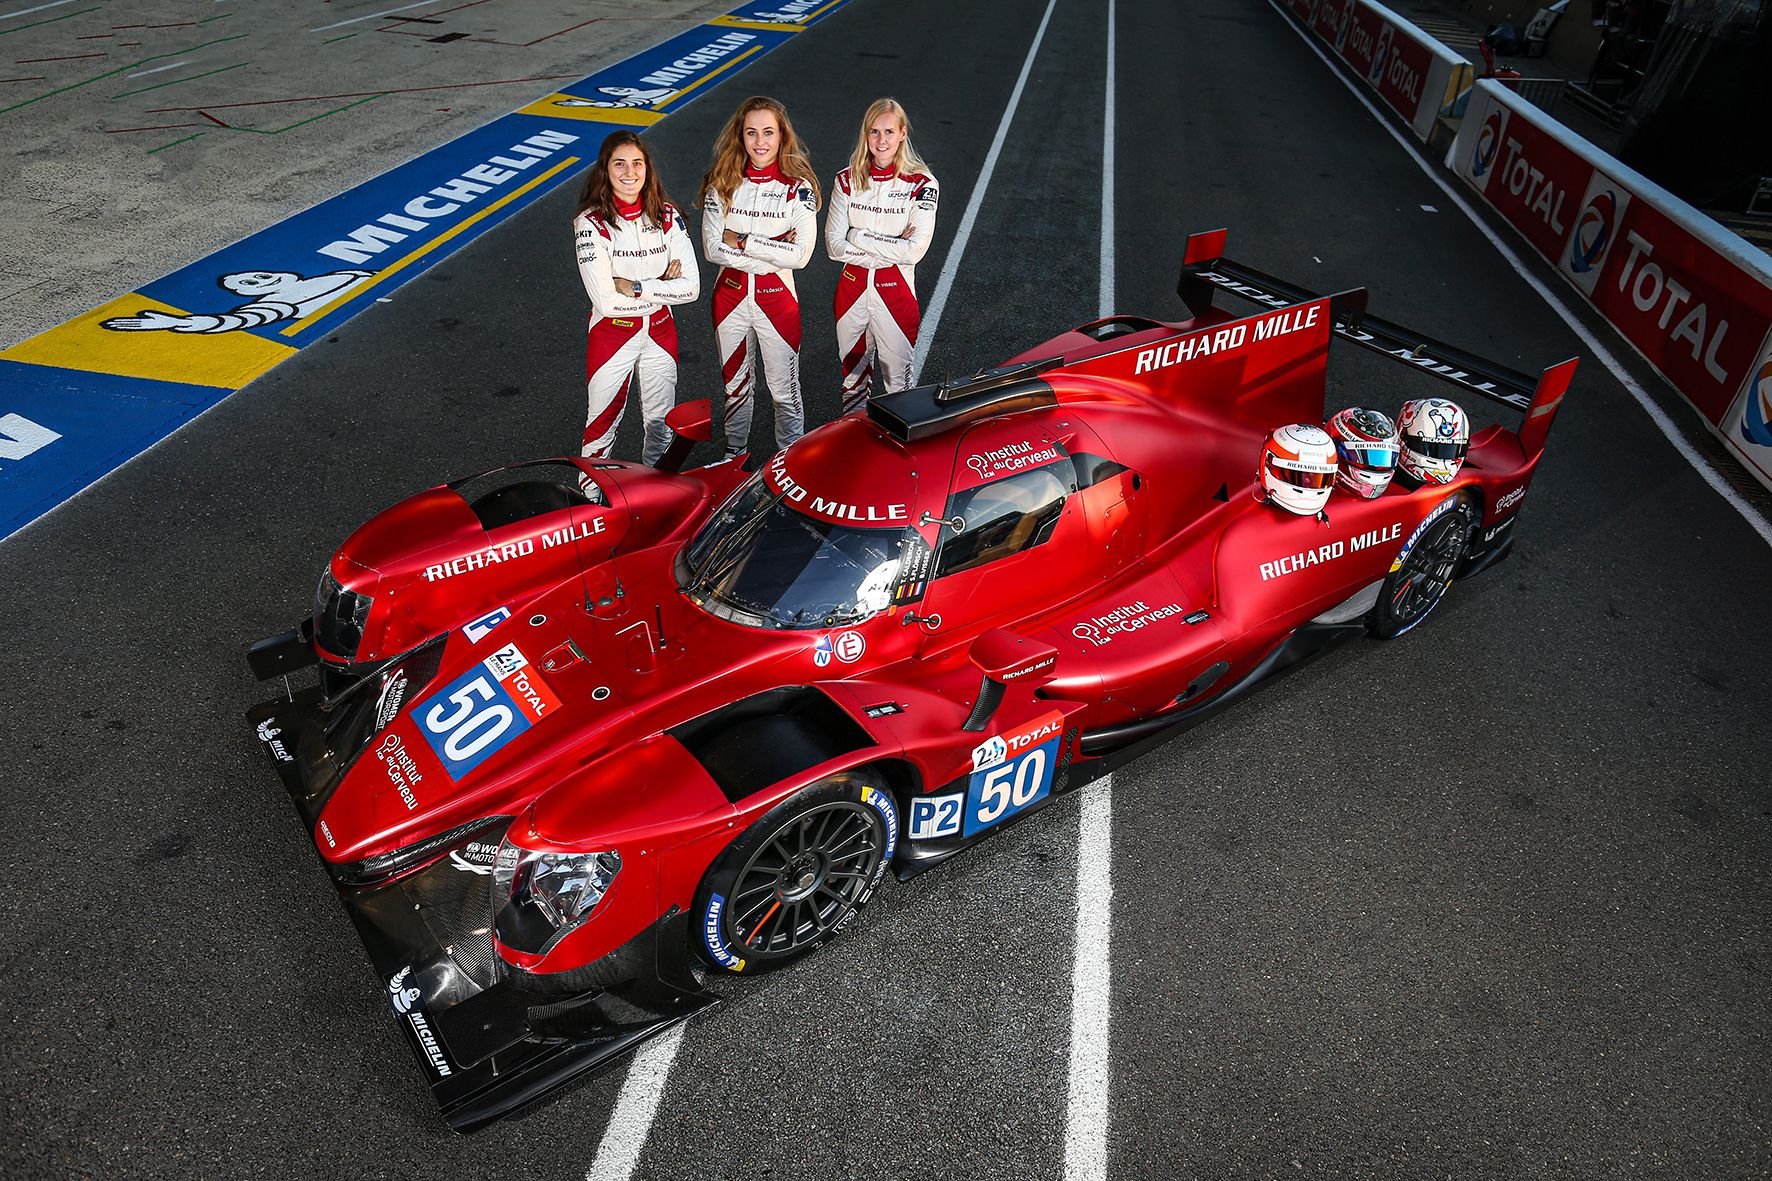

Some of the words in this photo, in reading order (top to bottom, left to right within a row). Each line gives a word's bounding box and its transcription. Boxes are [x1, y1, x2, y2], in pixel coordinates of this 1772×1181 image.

[639, 32, 757, 87] MICHELIN
[1351, 15, 1374, 62] TOTAL
[1387, 45, 1419, 104] TOTAL
[316, 129, 580, 265] MICHELIN
[850, 202, 882, 213] RICHARD
[884, 207, 906, 215] MILLE
[1500, 135, 1565, 236] TOTAL
[728, 207, 760, 218] ICHARD
[762, 211, 787, 219] MILLE
[1617, 229, 1729, 385] TOTAL
[1134, 325, 1247, 375] RICHARD
[1252, 305, 1320, 342] MILLE
[985, 440, 1033, 463] Institut
[993, 461, 1006, 470] du
[1005, 447, 1058, 471] Cerveau
[1287, 462, 1318, 471] RICHARD
[809, 496, 908, 521] MILLE
[1406, 499, 1455, 548] MICHELIN
[425, 538, 534, 583] RICHARD
[541, 516, 606, 550] MILLE
[1259, 540, 1345, 581] RICHARD
[1350, 522, 1402, 553] MILLE
[1091, 600, 1150, 628] Institut
[1106, 624, 1121, 635] du
[1119, 602, 1184, 632] Cerveau
[816, 652, 828, 664] N
[1002, 666, 1034, 680] RICHARD
[1034, 657, 1054, 670] MILLE
[387, 688, 405, 722] WOMEN
[512, 670, 548, 717] TOTAL
[426, 675, 514, 761] 50
[1008, 721, 1061, 750] TOTAL
[387, 762, 419, 811] Cerveau
[394, 746, 423, 786] Institut
[977, 749, 1046, 824] 50
[877, 799, 898, 852] MICHELIN
[912, 799, 959, 834] P2
[707, 901, 729, 961] MICHELIN
[411, 1011, 452, 1077] MICHELIN
